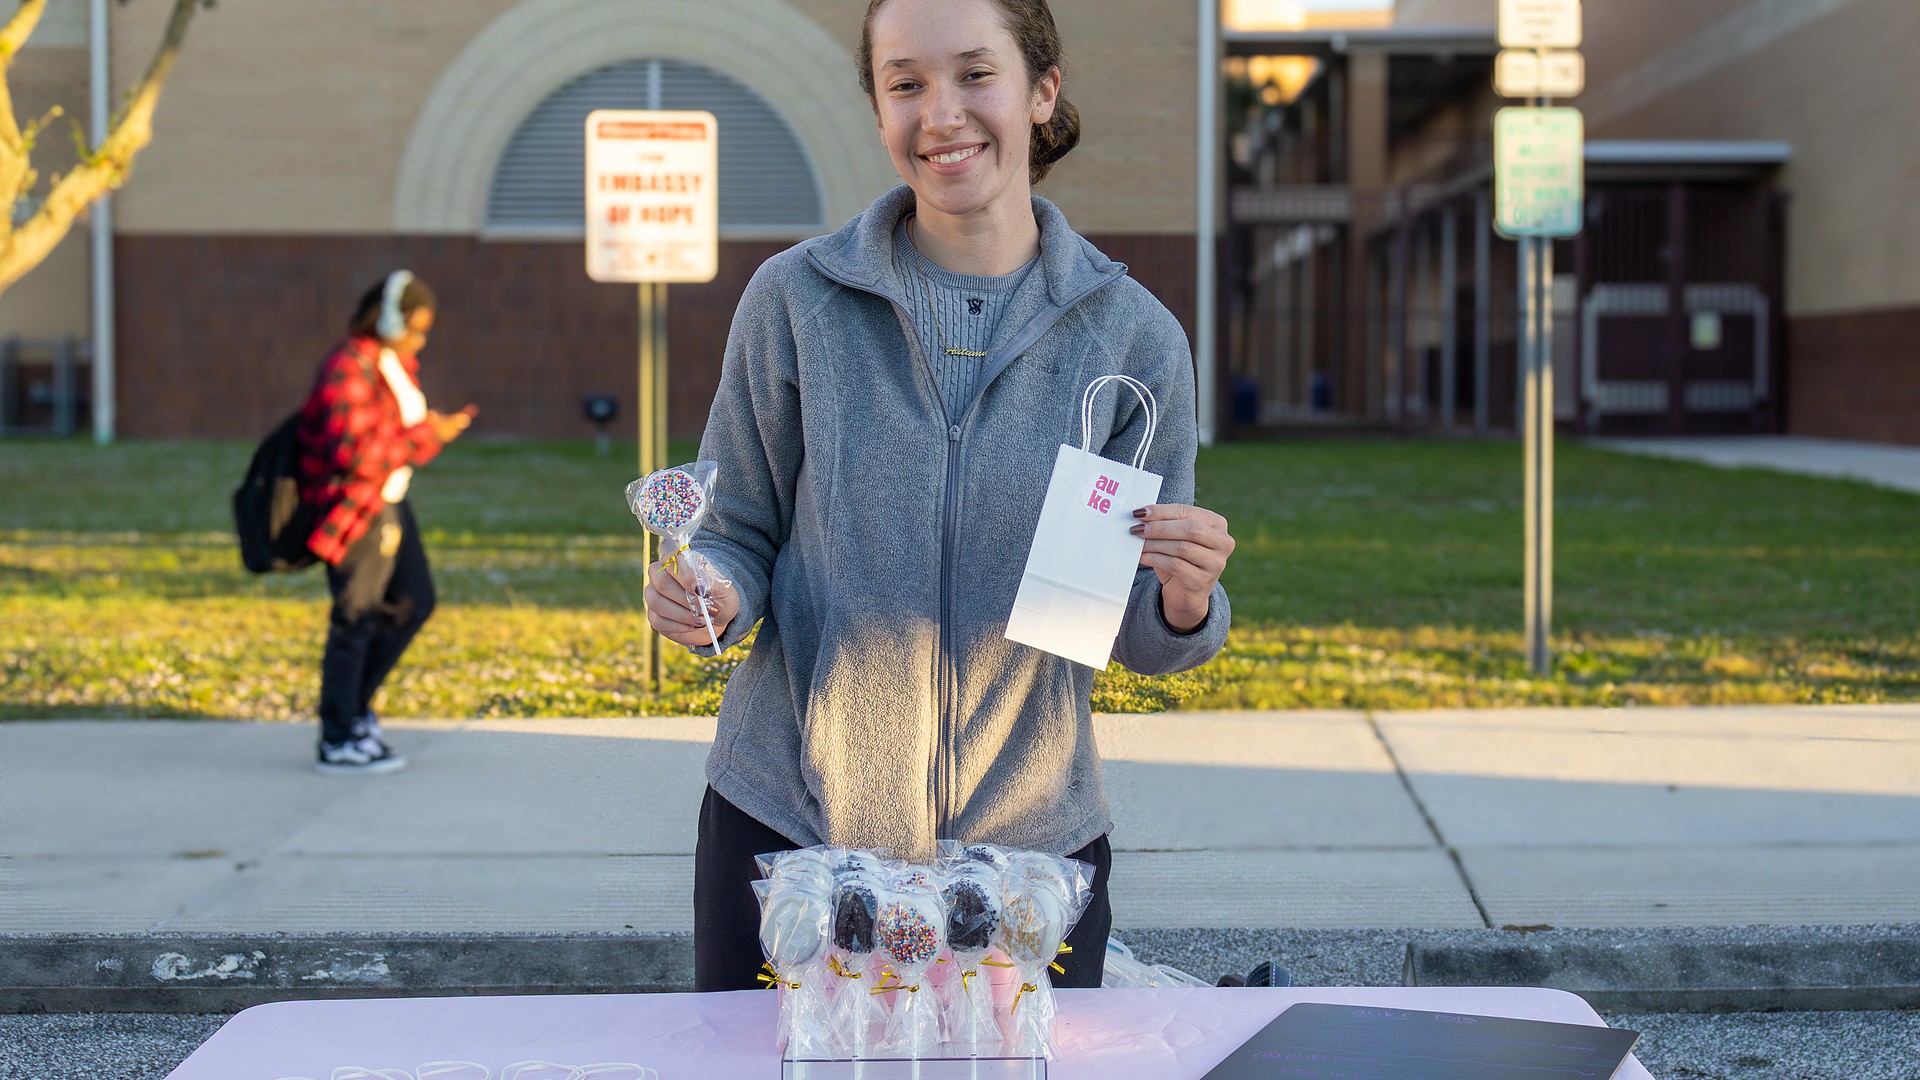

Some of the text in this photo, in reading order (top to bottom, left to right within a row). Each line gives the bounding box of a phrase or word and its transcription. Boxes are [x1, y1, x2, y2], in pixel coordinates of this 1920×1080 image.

[599, 174, 703, 192] EMBASSY
[609, 206, 694, 223] OF HOPE
[1095, 475, 1120, 497] au
[1087, 489, 1111, 514] ke
